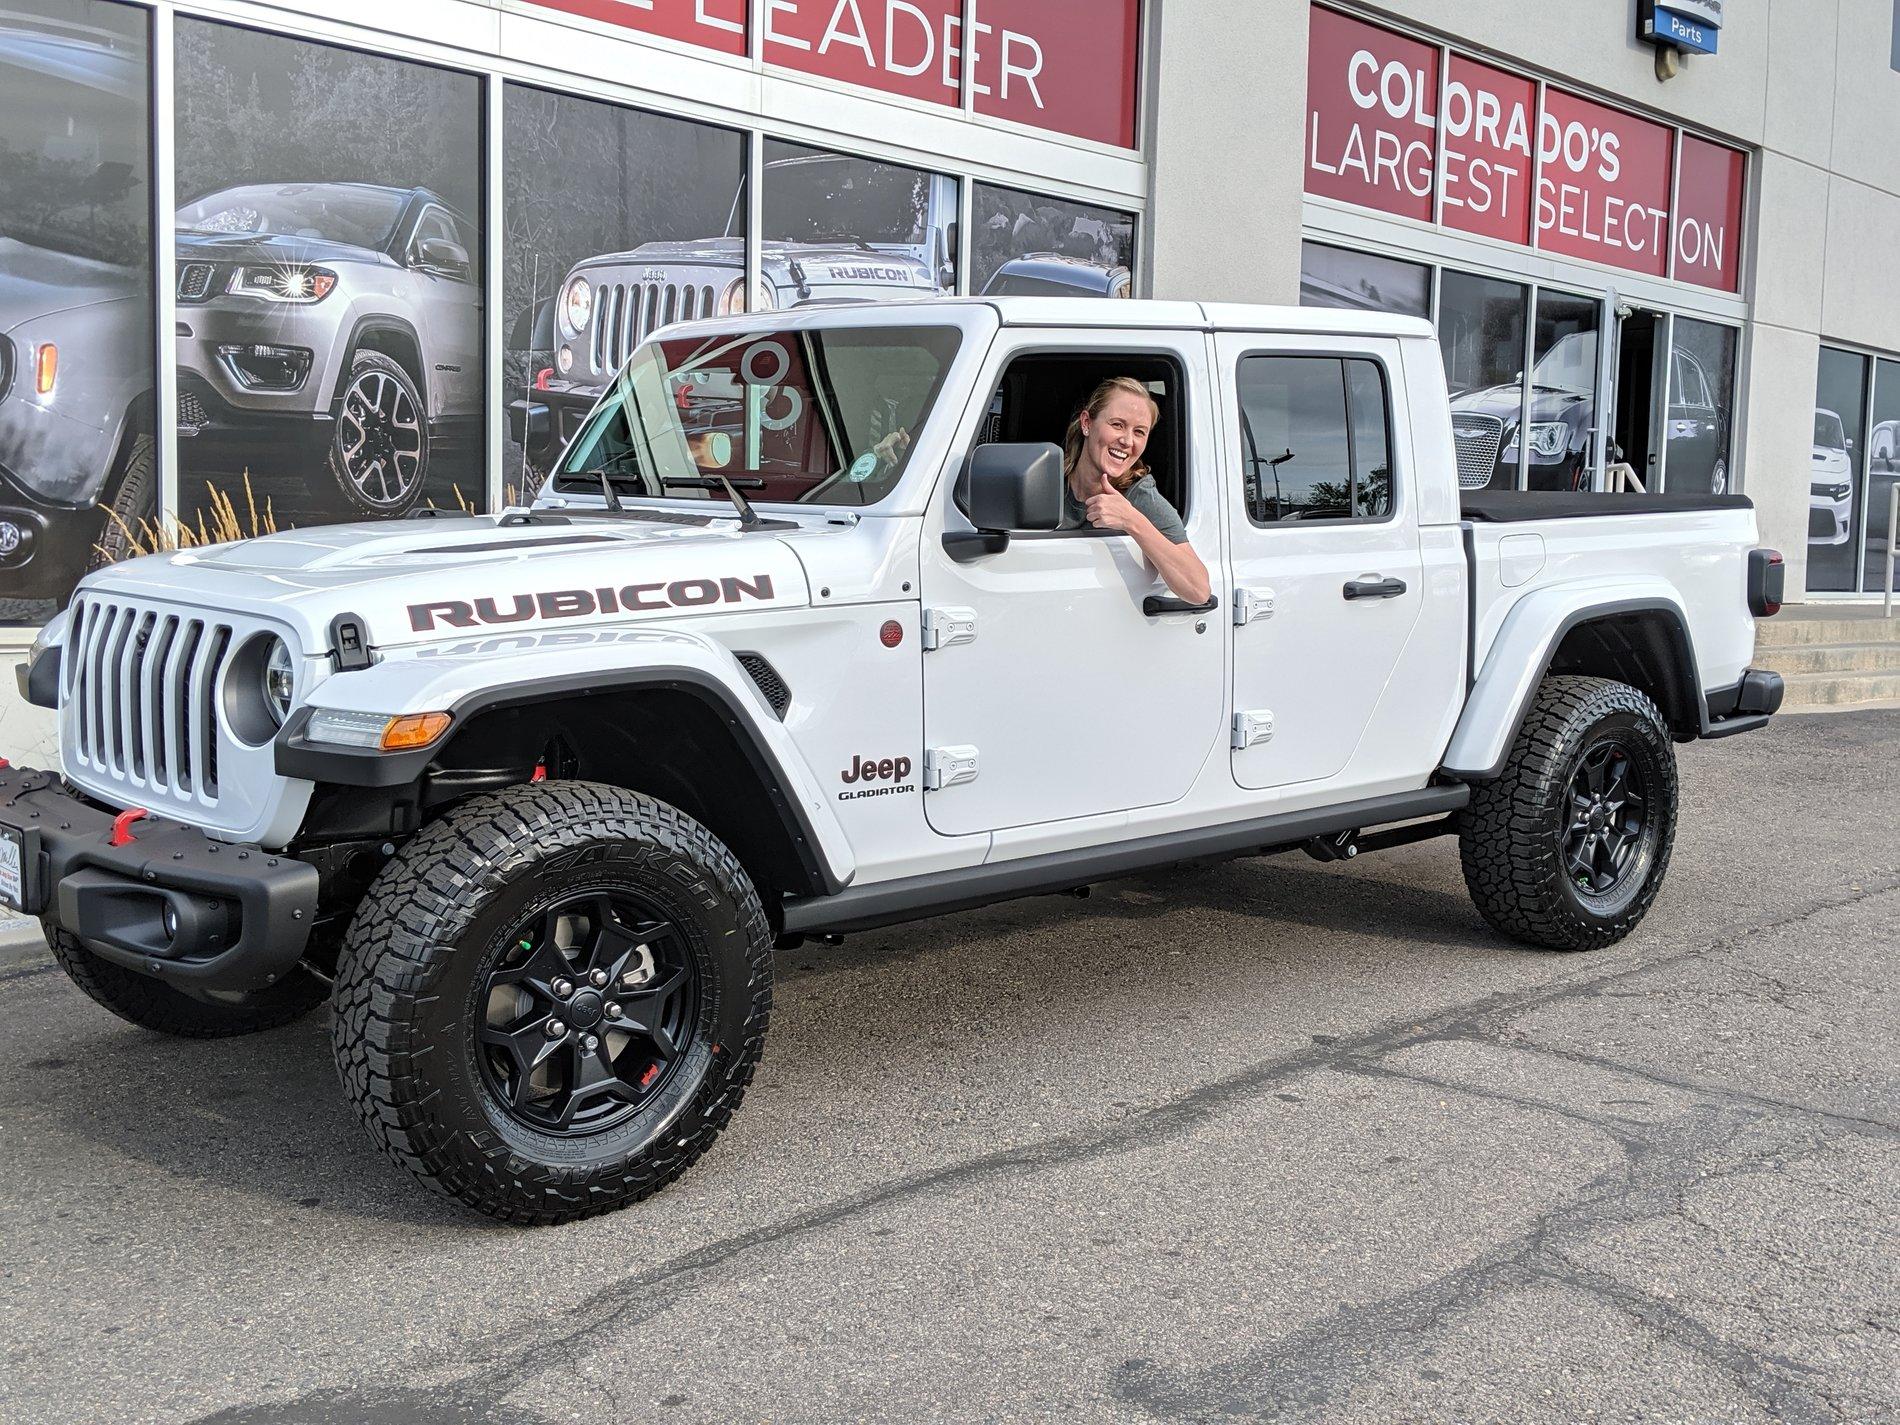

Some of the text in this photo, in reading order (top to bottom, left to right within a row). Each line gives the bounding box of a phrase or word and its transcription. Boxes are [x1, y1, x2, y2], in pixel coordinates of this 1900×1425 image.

[1671, 17, 1702, 43] Parts
[1348, 50, 1620, 182] COLORADO'S
[1311, 111, 1724, 270] LARGEST SELECTON
[828, 266, 908, 281] RUBICON
[406, 574, 775, 632] RUBICON
[841, 755, 912, 783] Jeep
[838, 784, 915, 801] GLADIATOR
